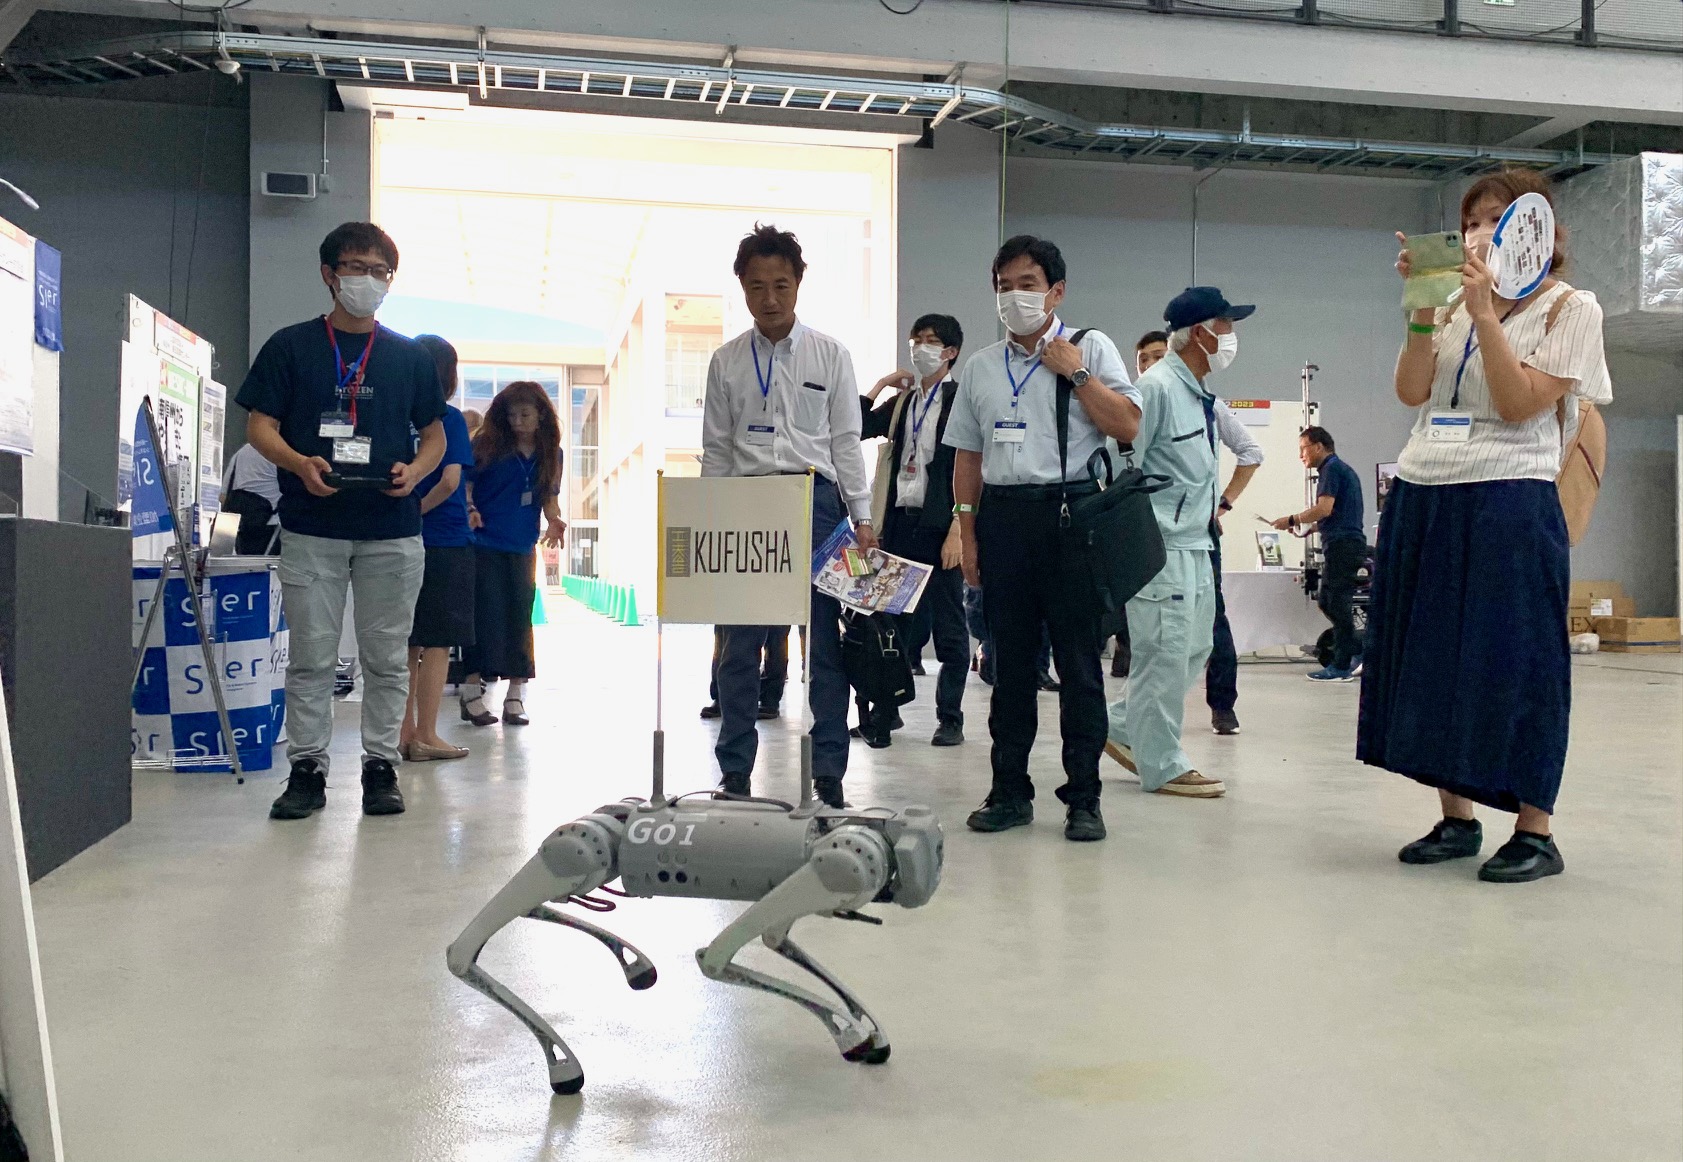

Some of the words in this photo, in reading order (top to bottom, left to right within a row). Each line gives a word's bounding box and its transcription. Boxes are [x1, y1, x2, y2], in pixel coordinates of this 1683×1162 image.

[694, 530, 791, 574] KUFUSHA
[181, 591, 261, 627] Ser
[184, 657, 264, 695] Ser
